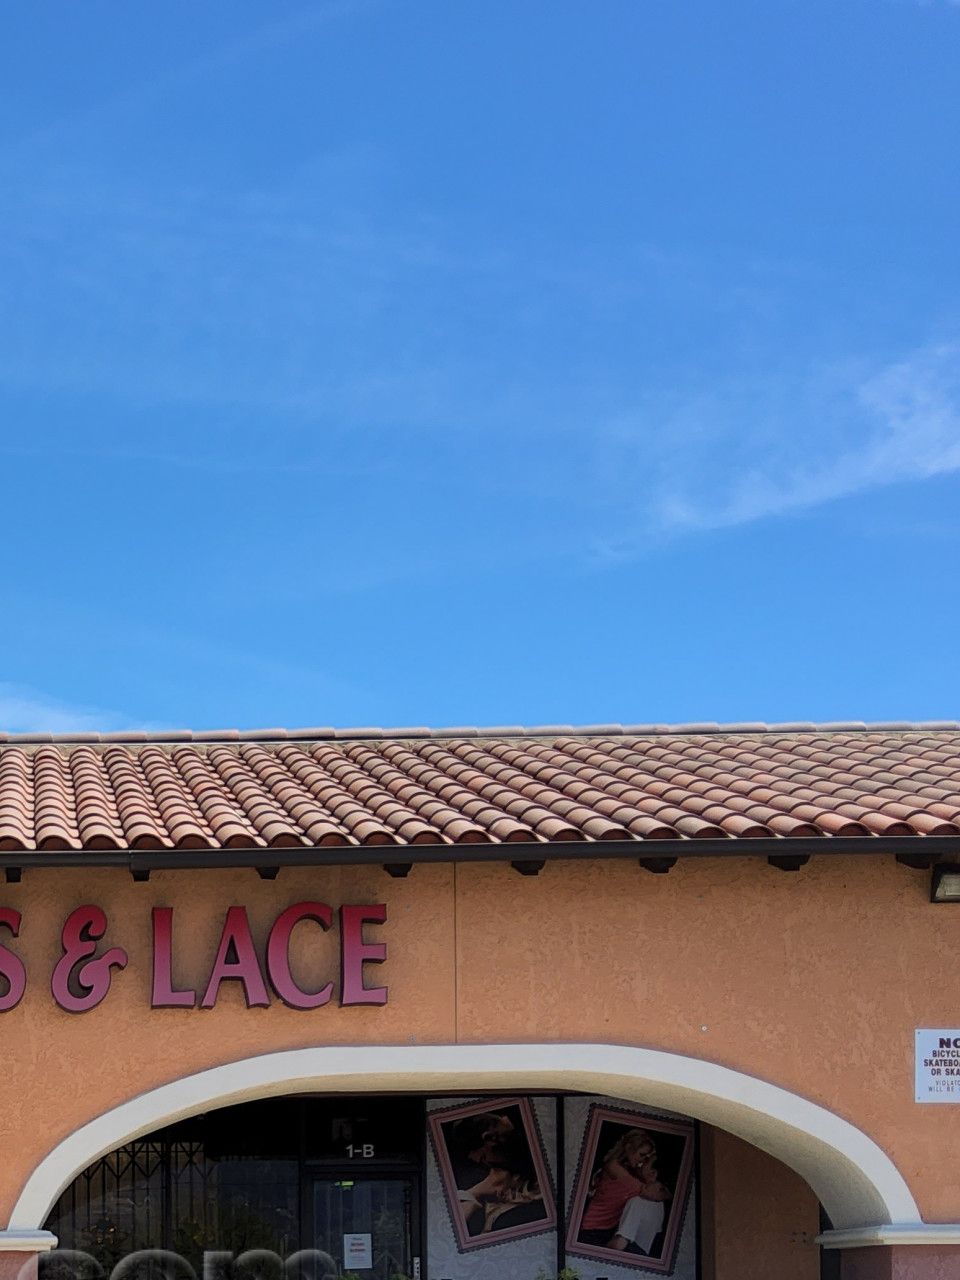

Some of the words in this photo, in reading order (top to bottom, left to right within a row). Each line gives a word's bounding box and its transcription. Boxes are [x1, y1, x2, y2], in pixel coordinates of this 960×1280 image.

[51, 904, 128, 1014] &
[151, 901, 388, 1011] LACE
[924, 1059, 960, 1067] SKATEBO
[931, 1068, 942, 1076] OR
[345, 1144, 375, 1158] 1-B
